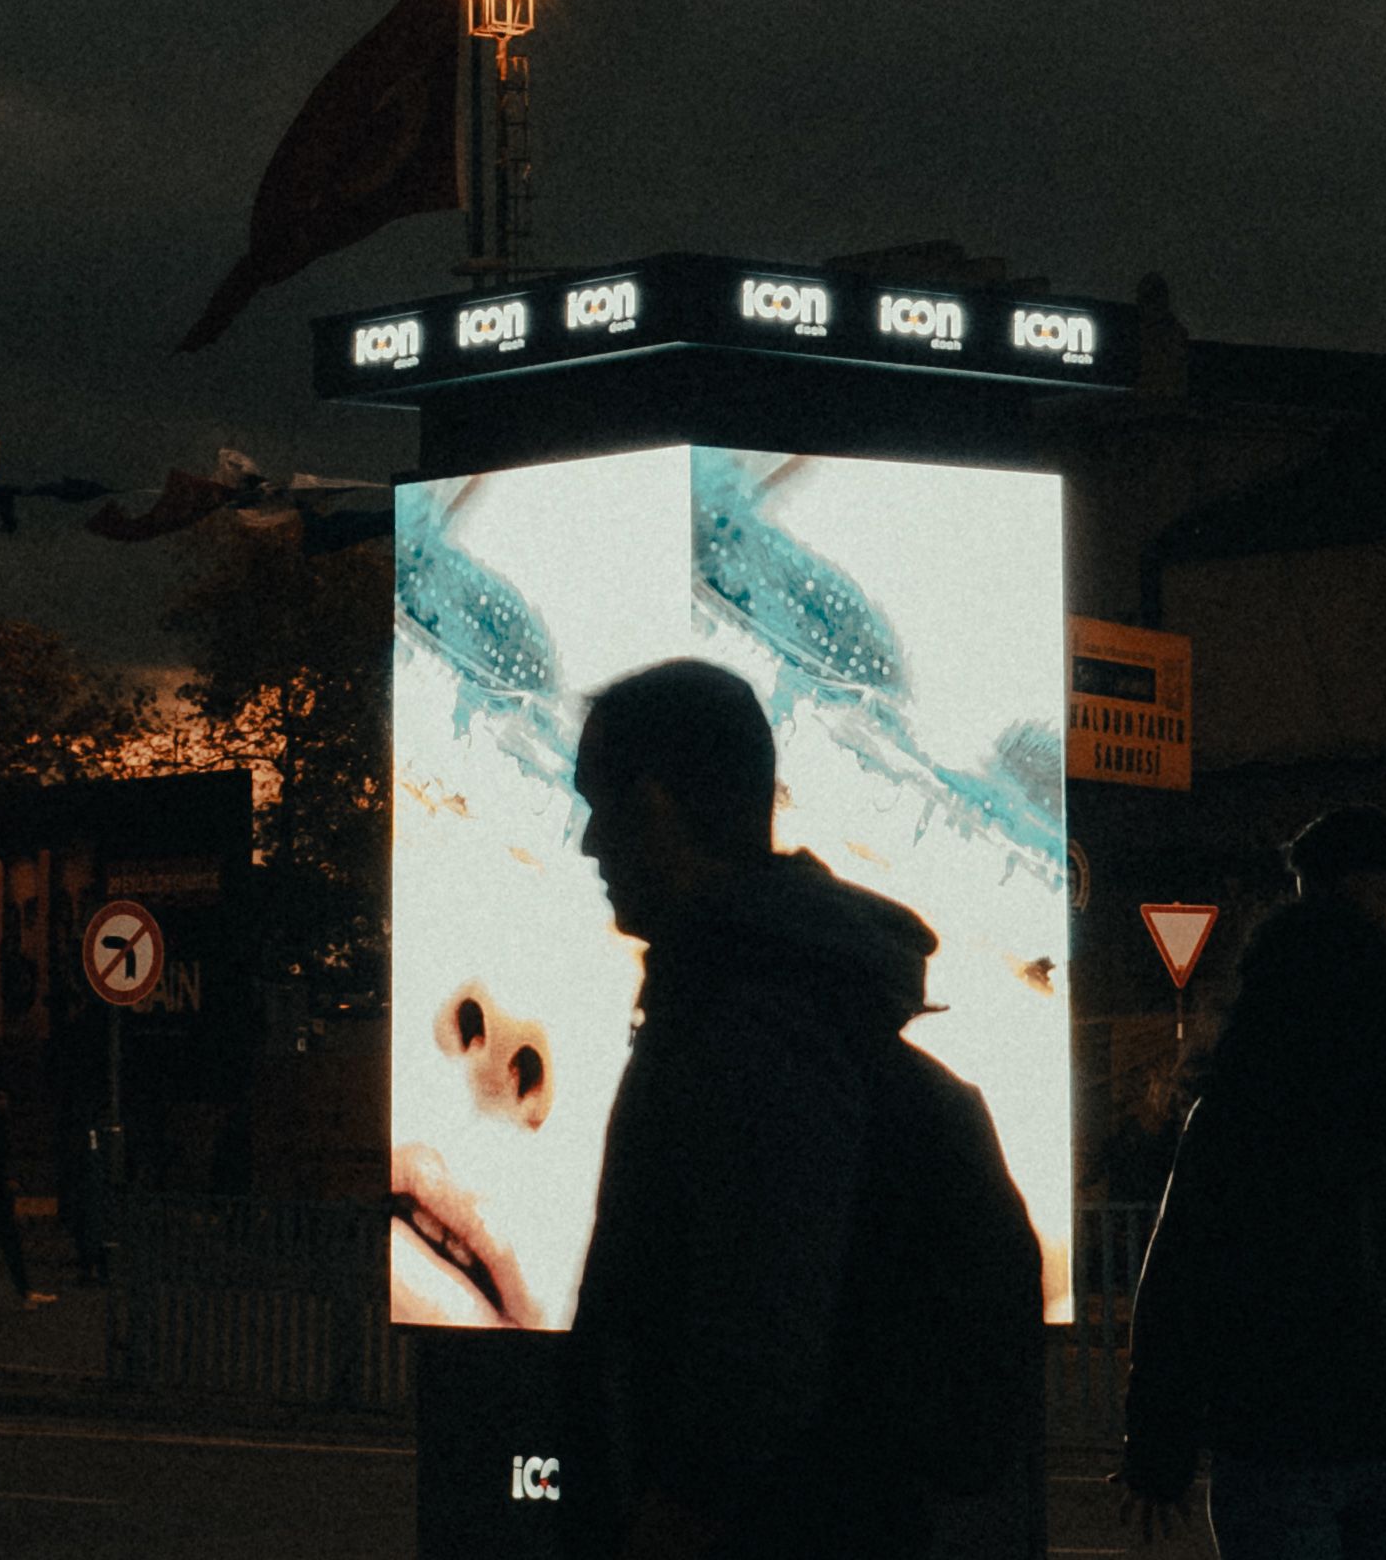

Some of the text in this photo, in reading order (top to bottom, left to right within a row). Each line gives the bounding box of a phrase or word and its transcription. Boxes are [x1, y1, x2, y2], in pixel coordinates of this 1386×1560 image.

[459, 301, 525, 347] icon
[566, 281, 636, 329] icon
[741, 279, 828, 325] icon
[879, 294, 963, 339] icon
[355, 320, 419, 366] icon
[1013, 309, 1094, 353] icon
